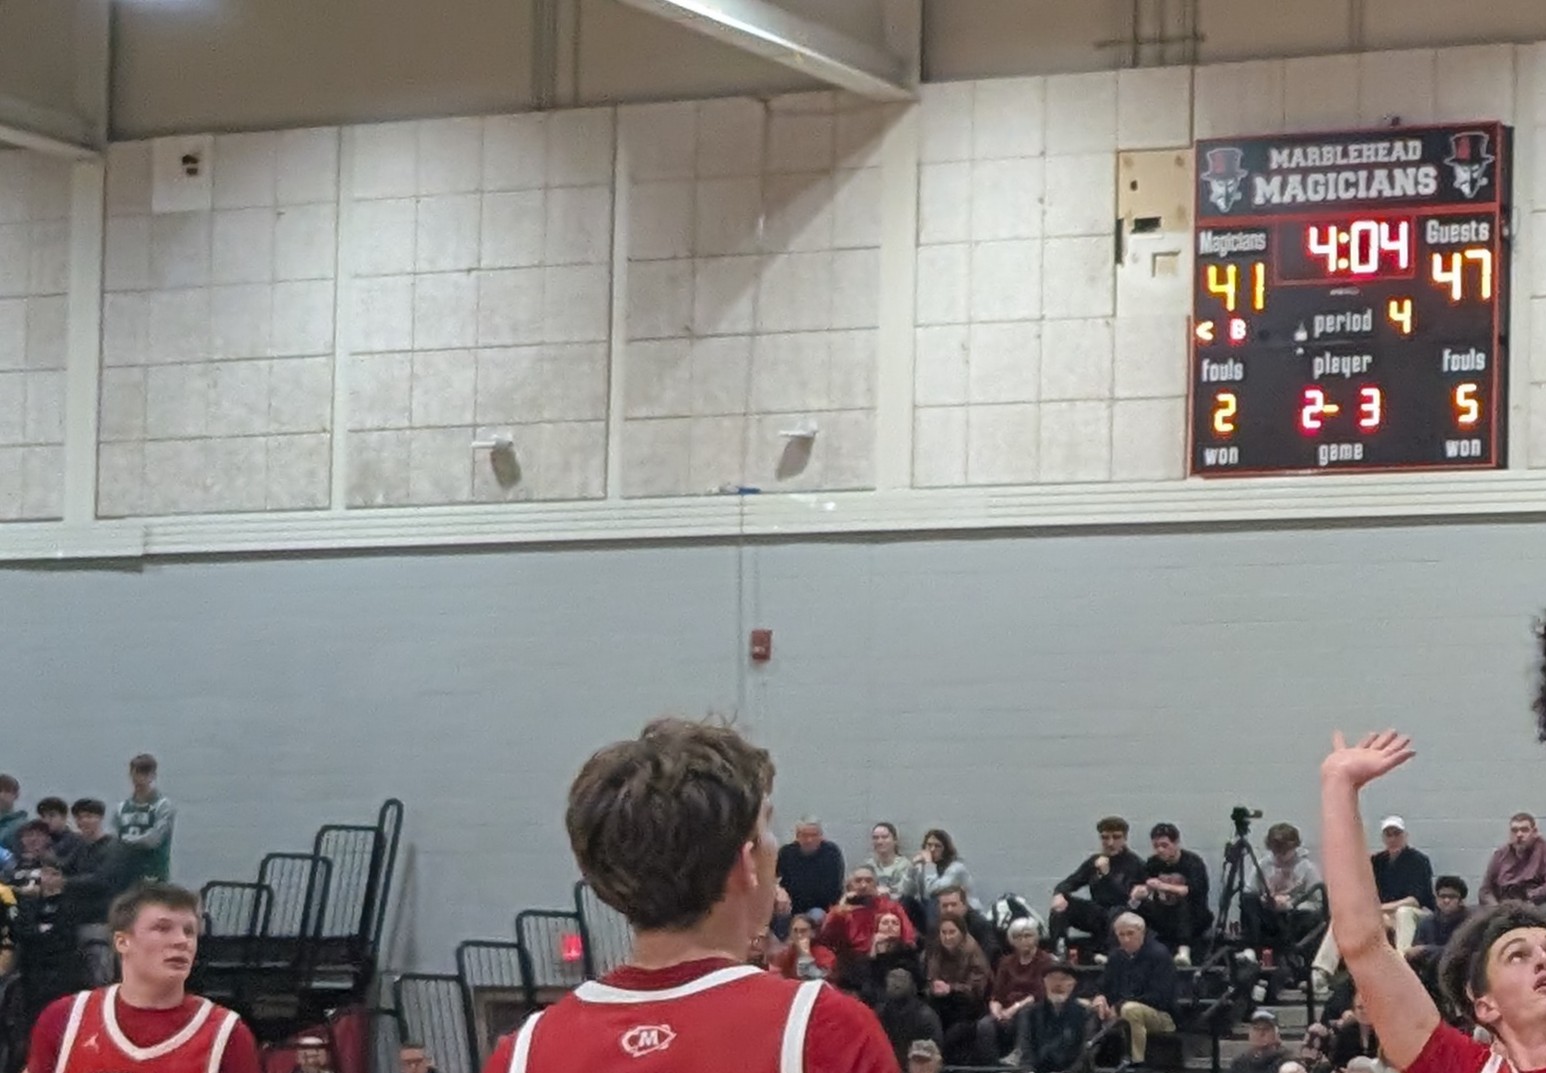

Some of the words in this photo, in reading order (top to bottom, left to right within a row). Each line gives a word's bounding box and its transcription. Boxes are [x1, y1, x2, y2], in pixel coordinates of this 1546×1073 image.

[1270, 140, 1423, 170] MARBLEHEAD
[1253, 166, 1438, 206] MAGICIANS
[1199, 230, 1267, 258] Magicians
[1425, 219, 1490, 244] Guests
[1309, 220, 1409, 274] 4:04
[1207, 262, 1265, 312] 41
[1432, 248, 1492, 301] 47
[1313, 308, 1373, 338] period
[1389, 299, 1412, 334] 4
[1202, 358, 1244, 382] fouls
[1313, 351, 1373, 380] player
[1442, 348, 1486, 372] fouls
[1214, 393, 1236, 432] 2
[1360, 387, 1381, 427] 3
[1456, 383, 1478, 423] 5
[1204, 447, 1239, 466] won
[1318, 443, 1364, 466] game
[1445, 439, 1481, 457] won
